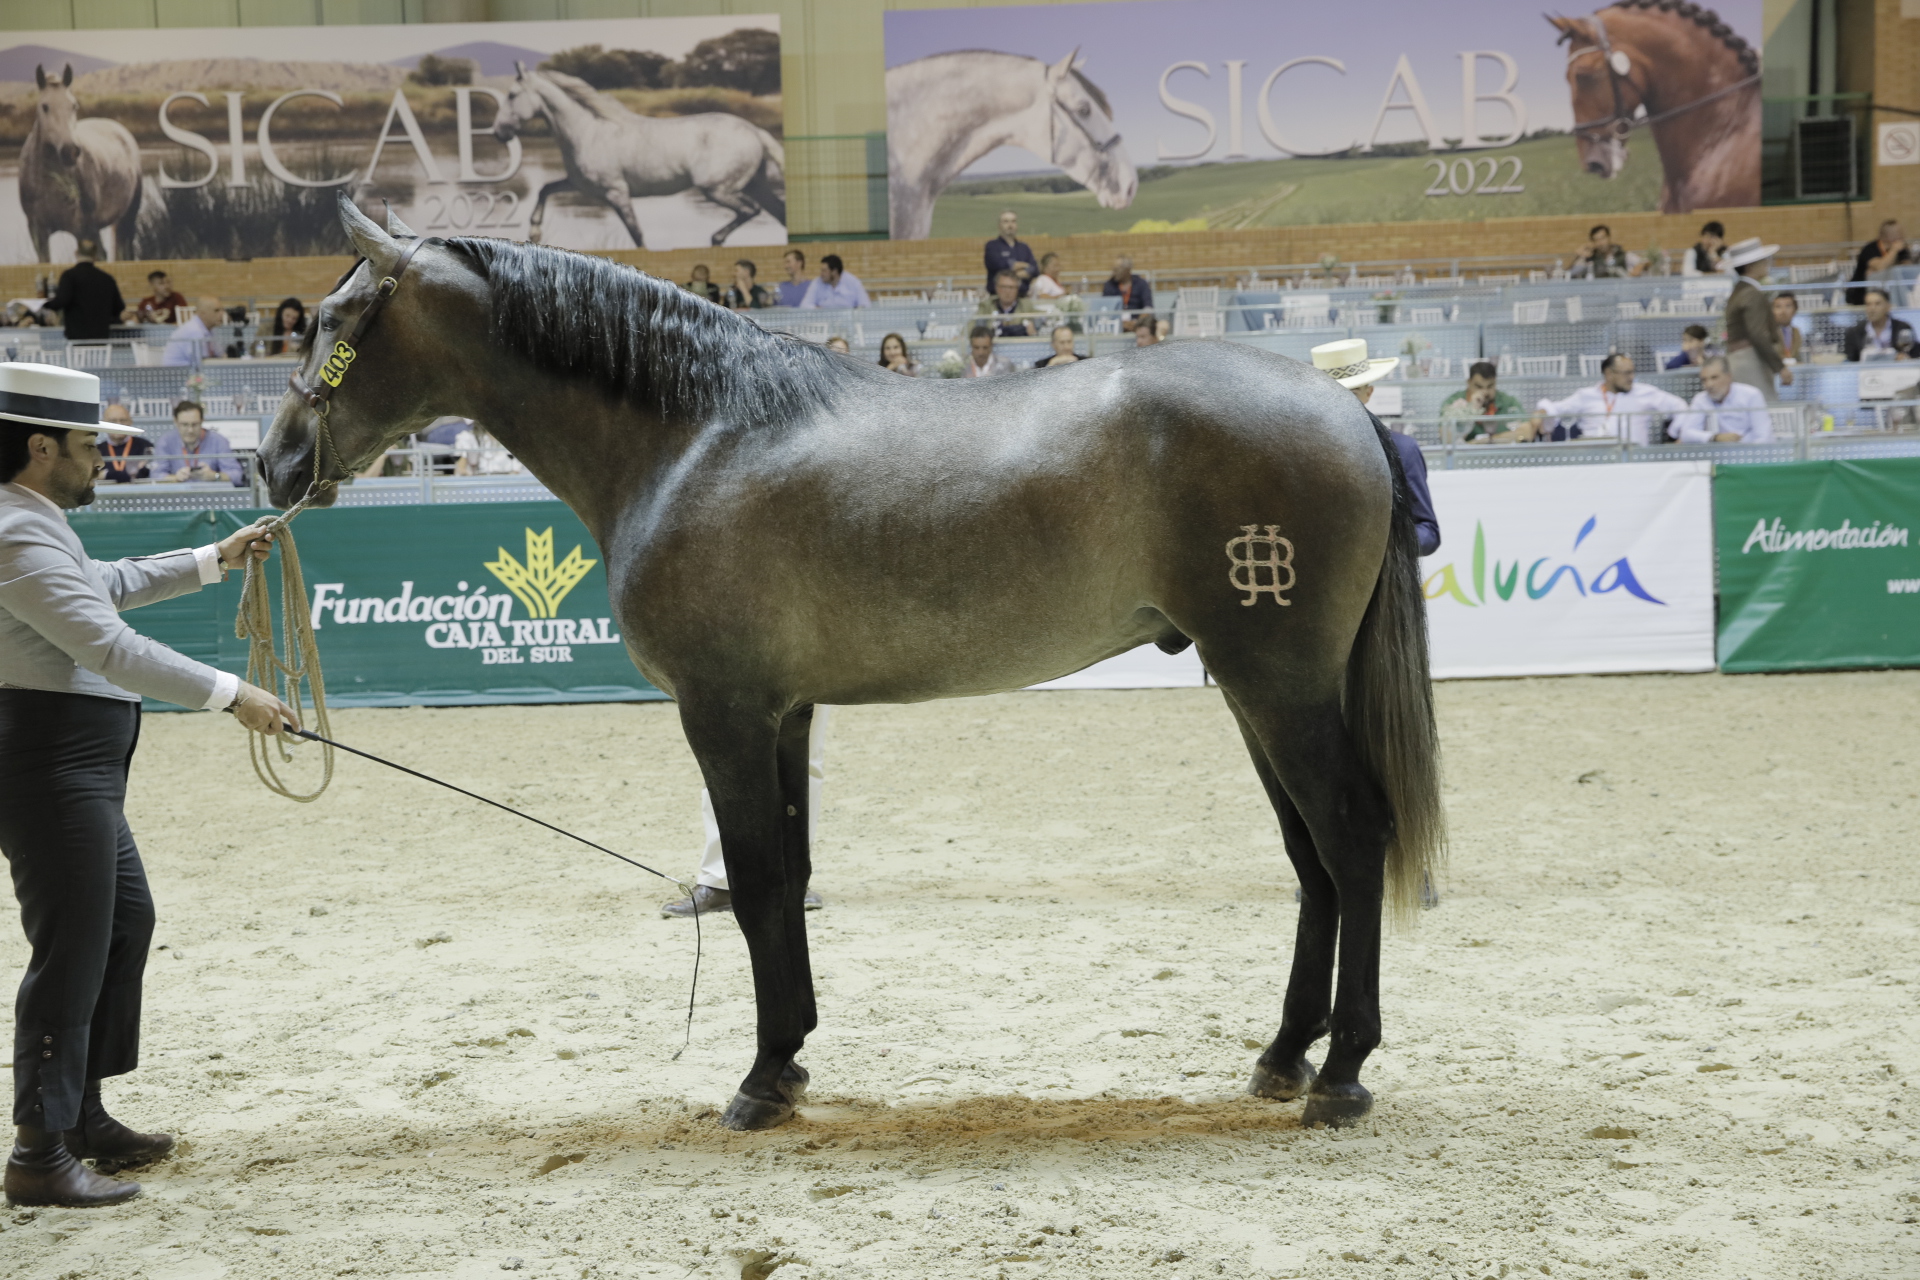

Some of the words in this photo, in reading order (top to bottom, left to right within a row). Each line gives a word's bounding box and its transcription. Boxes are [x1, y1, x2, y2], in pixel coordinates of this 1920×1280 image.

[1156, 50, 1528, 160] SICAB
[158, 87, 522, 188] SICAB
[1423, 156, 1525, 197] 2022
[424, 190, 523, 231] 2022
[323, 342, 354, 383] 403
[1742, 516, 1908, 554] Alimentación
[310, 581, 514, 630] Fundación
[424, 620, 505, 649] CAJA
[511, 618, 620, 647] RURAL
[481, 648, 524, 664] DEL
[530, 646, 573, 663] SUR
